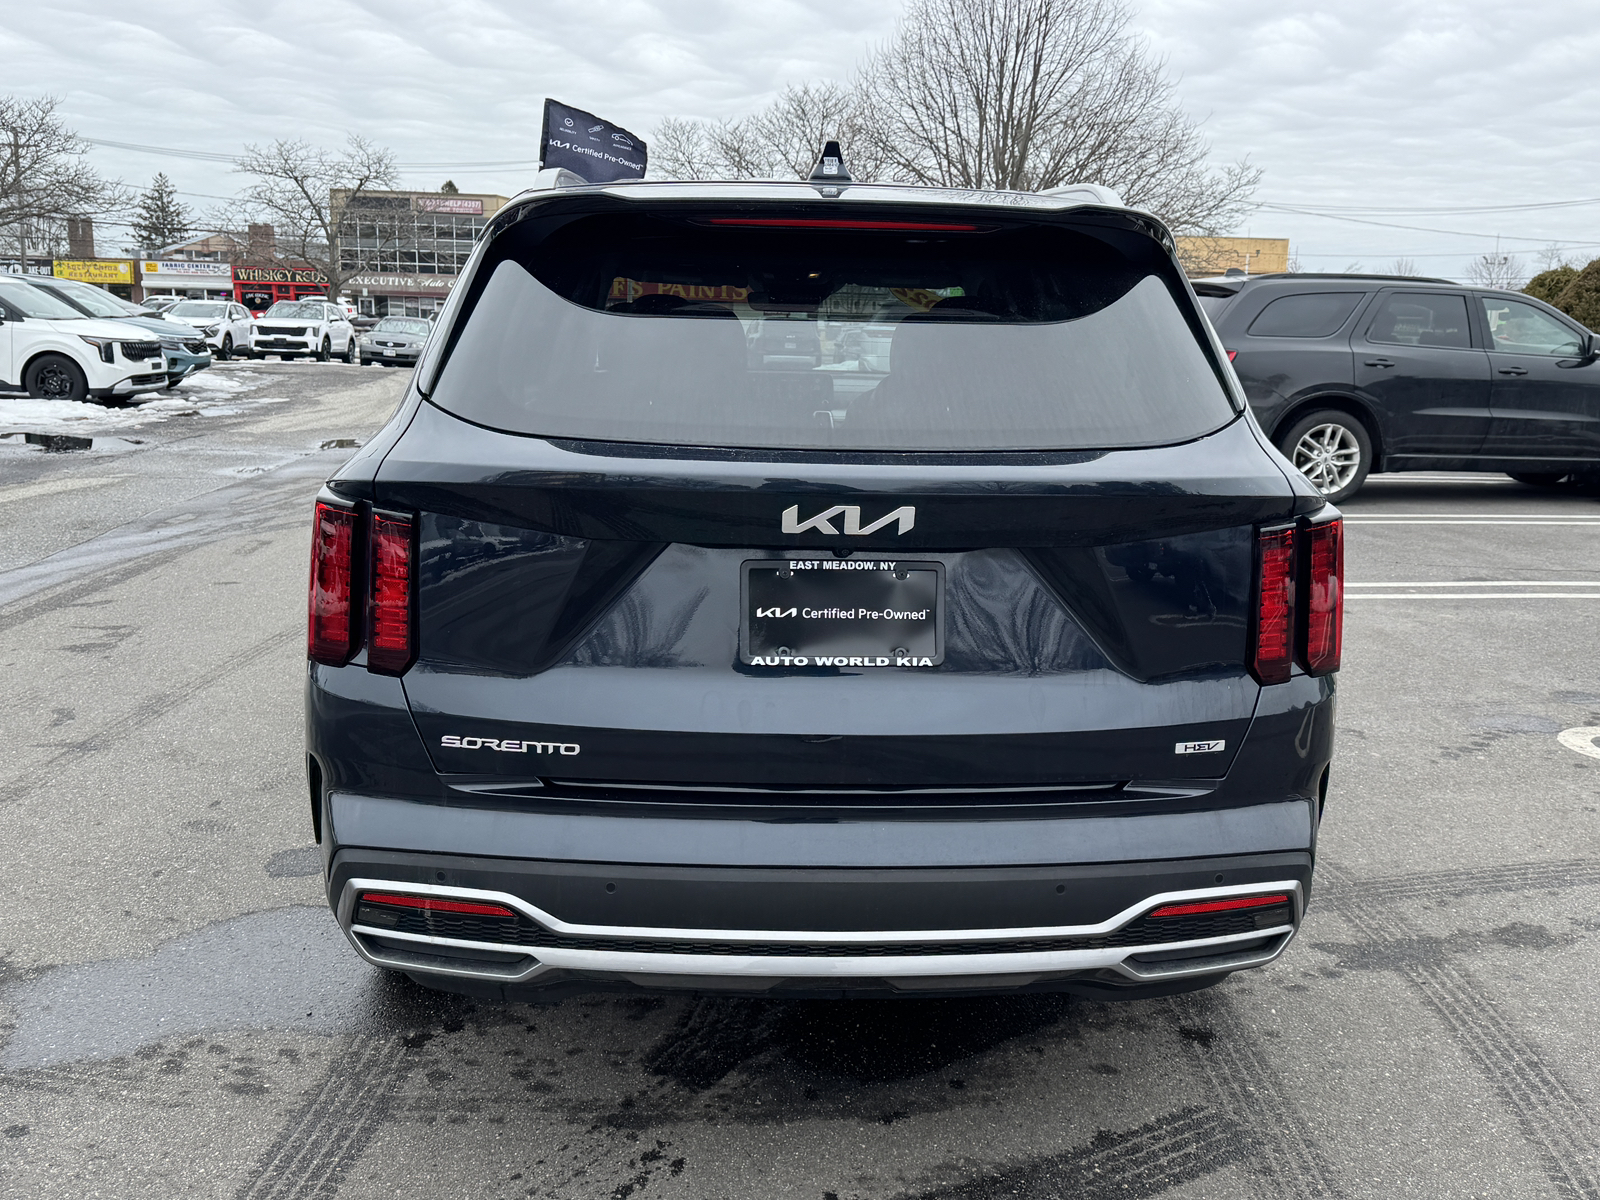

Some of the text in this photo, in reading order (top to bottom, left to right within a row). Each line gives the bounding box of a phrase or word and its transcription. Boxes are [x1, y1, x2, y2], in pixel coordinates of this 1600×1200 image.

[549, 138, 570, 149] KIA
[572, 144, 603, 159] Certified
[237, 268, 293, 282] WHISKEY
[348, 276, 414, 287] EXECUTIVE
[417, 278, 445, 287] Auto
[781, 504, 916, 536] KIA
[789, 560, 820, 570] EAST
[879, 562, 896, 571] NY
[756, 606, 798, 618] KIA
[802, 607, 855, 619] Certified
[750, 656, 934, 667] AUTO WORLD KIA
[440, 734, 581, 756] SORENTO
[1184, 742, 1220, 752] HEV
